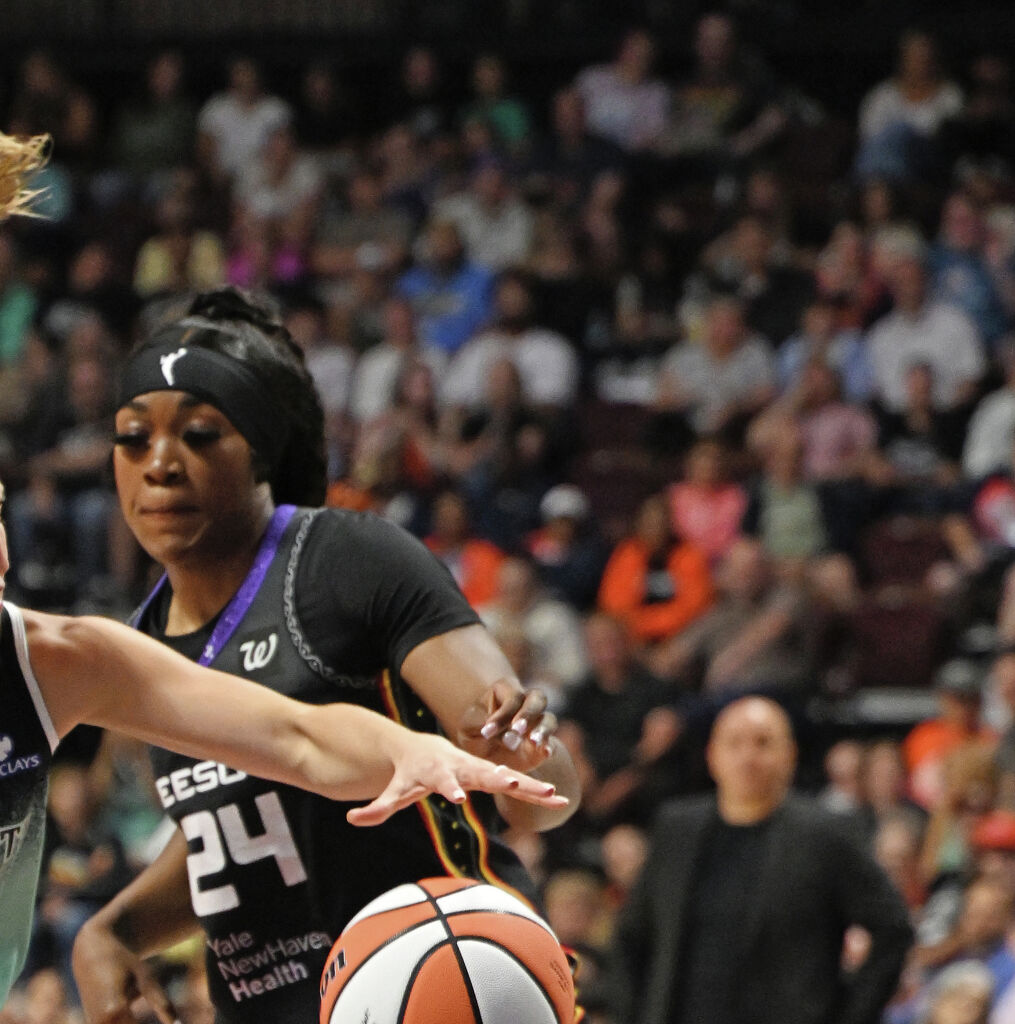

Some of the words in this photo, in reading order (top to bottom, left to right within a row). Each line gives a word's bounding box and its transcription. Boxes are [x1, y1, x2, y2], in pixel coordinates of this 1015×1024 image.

[180, 791, 308, 918] 24
[206, 932, 253, 958] Yale
[229, 960, 308, 1002] Health
